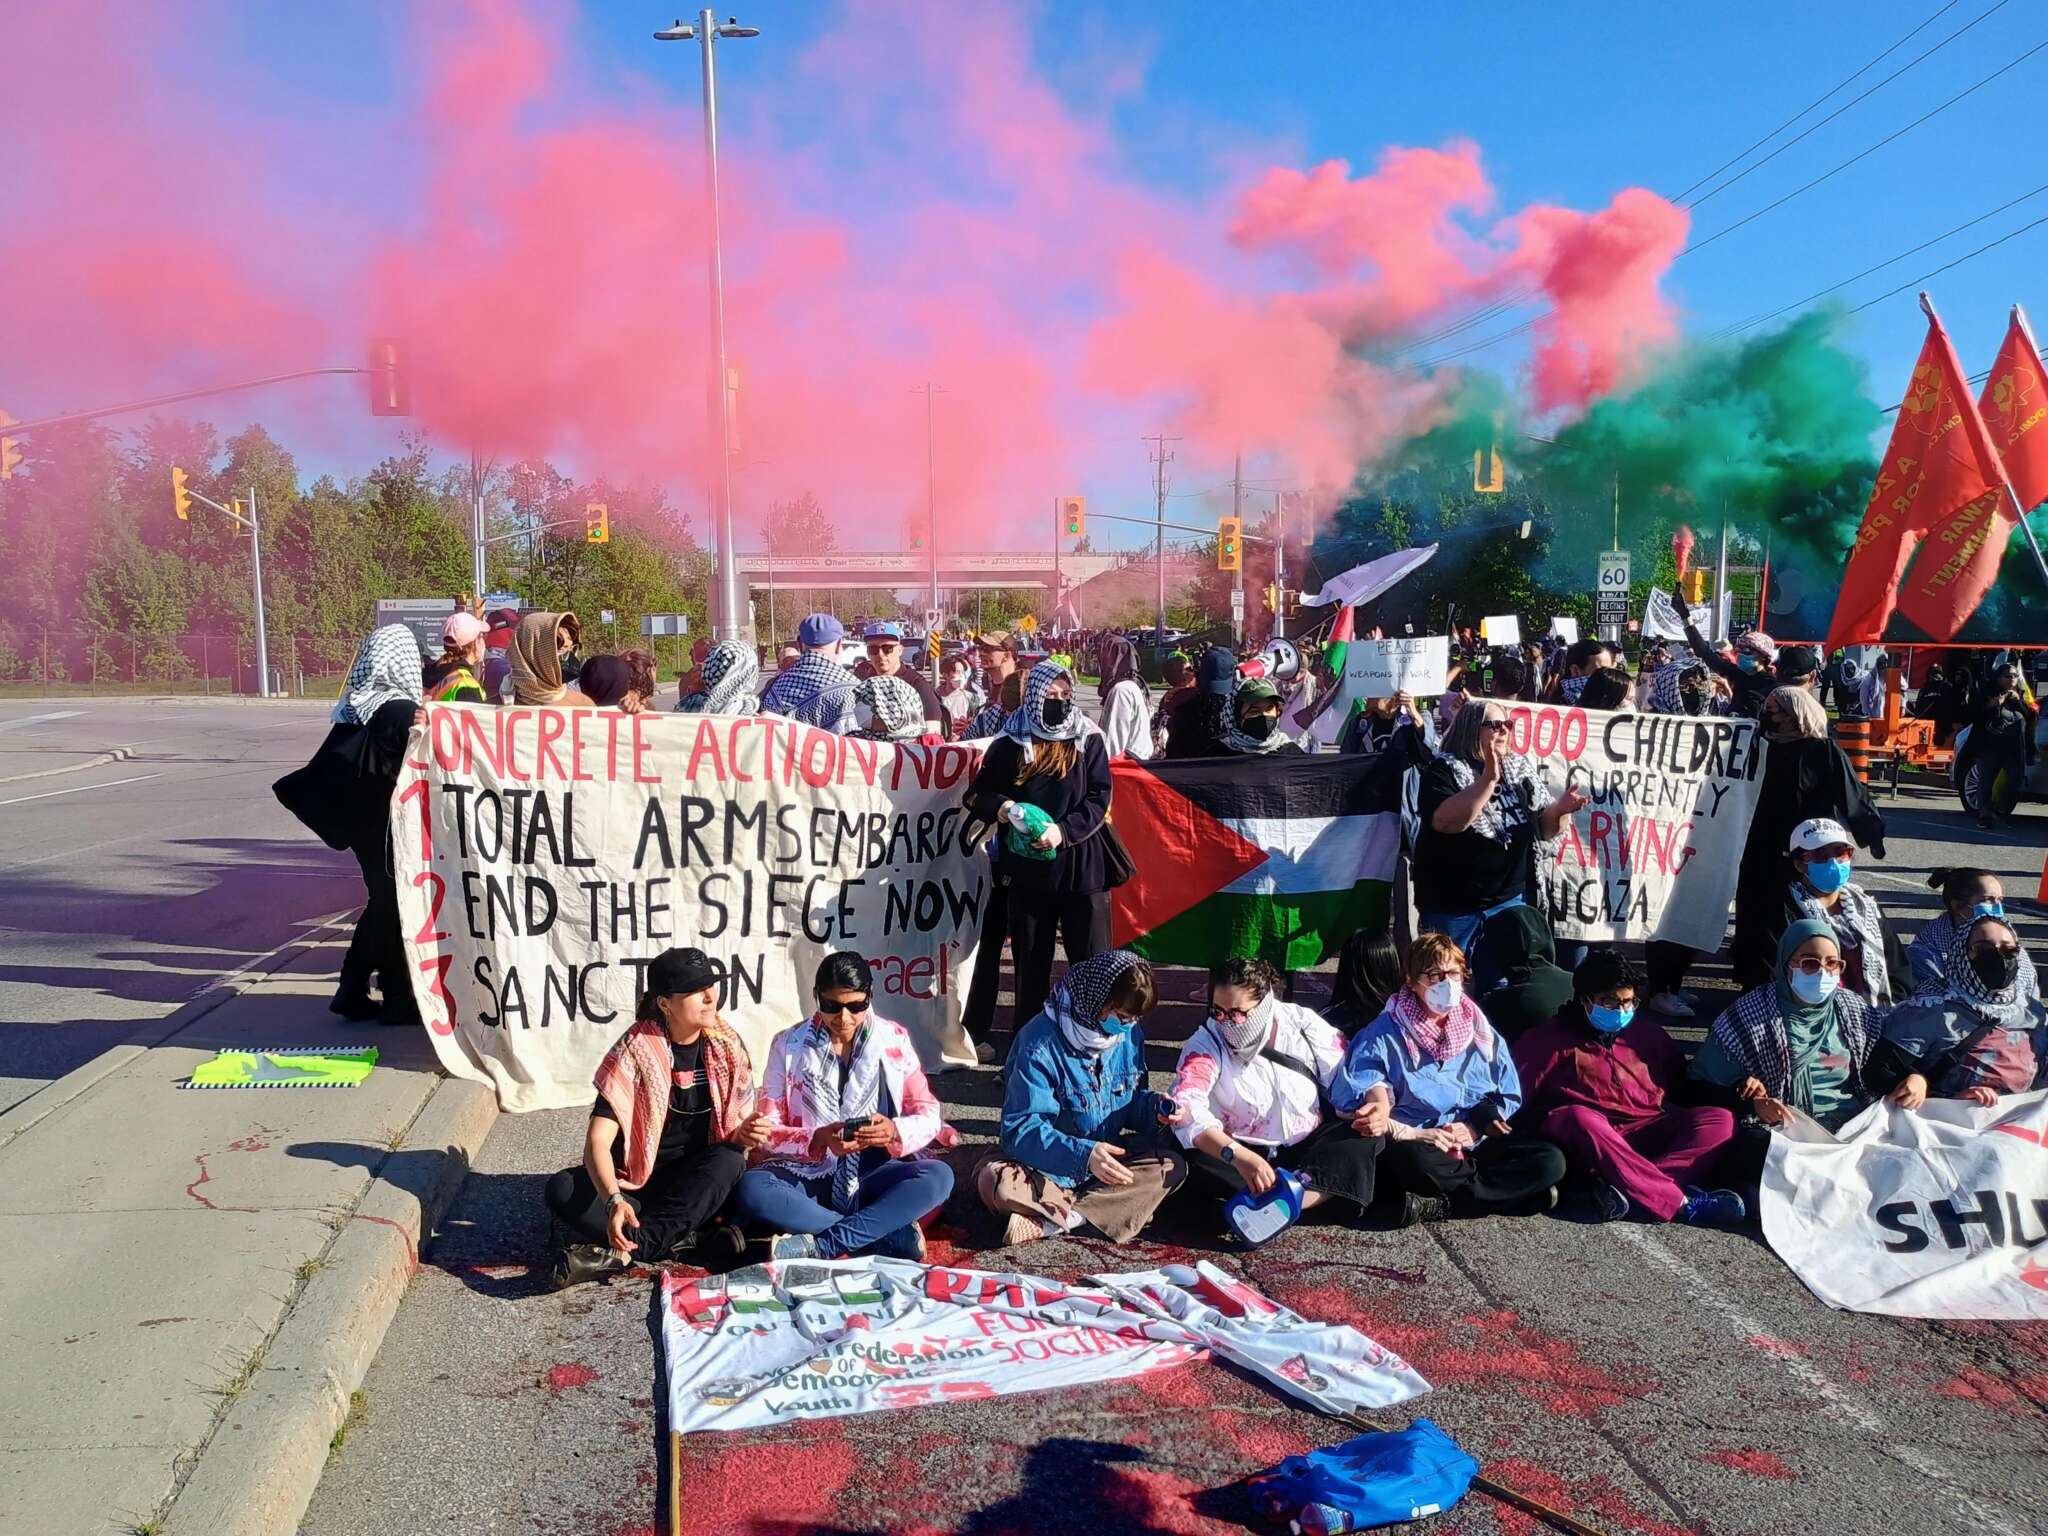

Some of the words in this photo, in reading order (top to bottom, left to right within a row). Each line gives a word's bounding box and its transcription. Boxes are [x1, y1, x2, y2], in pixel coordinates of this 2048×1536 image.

[1602, 568, 1626, 585] 60
[1600, 602, 1626, 610] BEGINS
[1601, 612, 1624, 622] DÉBUT
[1350, 670, 1392, 679] WEAPONS
[1376, 640, 1428, 654] PEACE!
[685, 717, 878, 790] ACTION
[1603, 713, 1760, 782] CHILDREN
[442, 782, 596, 868] TOTAL
[632, 795, 803, 869] ARMS
[1555, 811, 1698, 876] ARVING
[462, 870, 558, 941] END
[580, 880, 673, 944] THE
[698, 869, 866, 944] SIEGE
[883, 877, 985, 937] NOW
[1576, 879, 1648, 925] GAZA
[474, 953, 765, 1030] SANCTON
